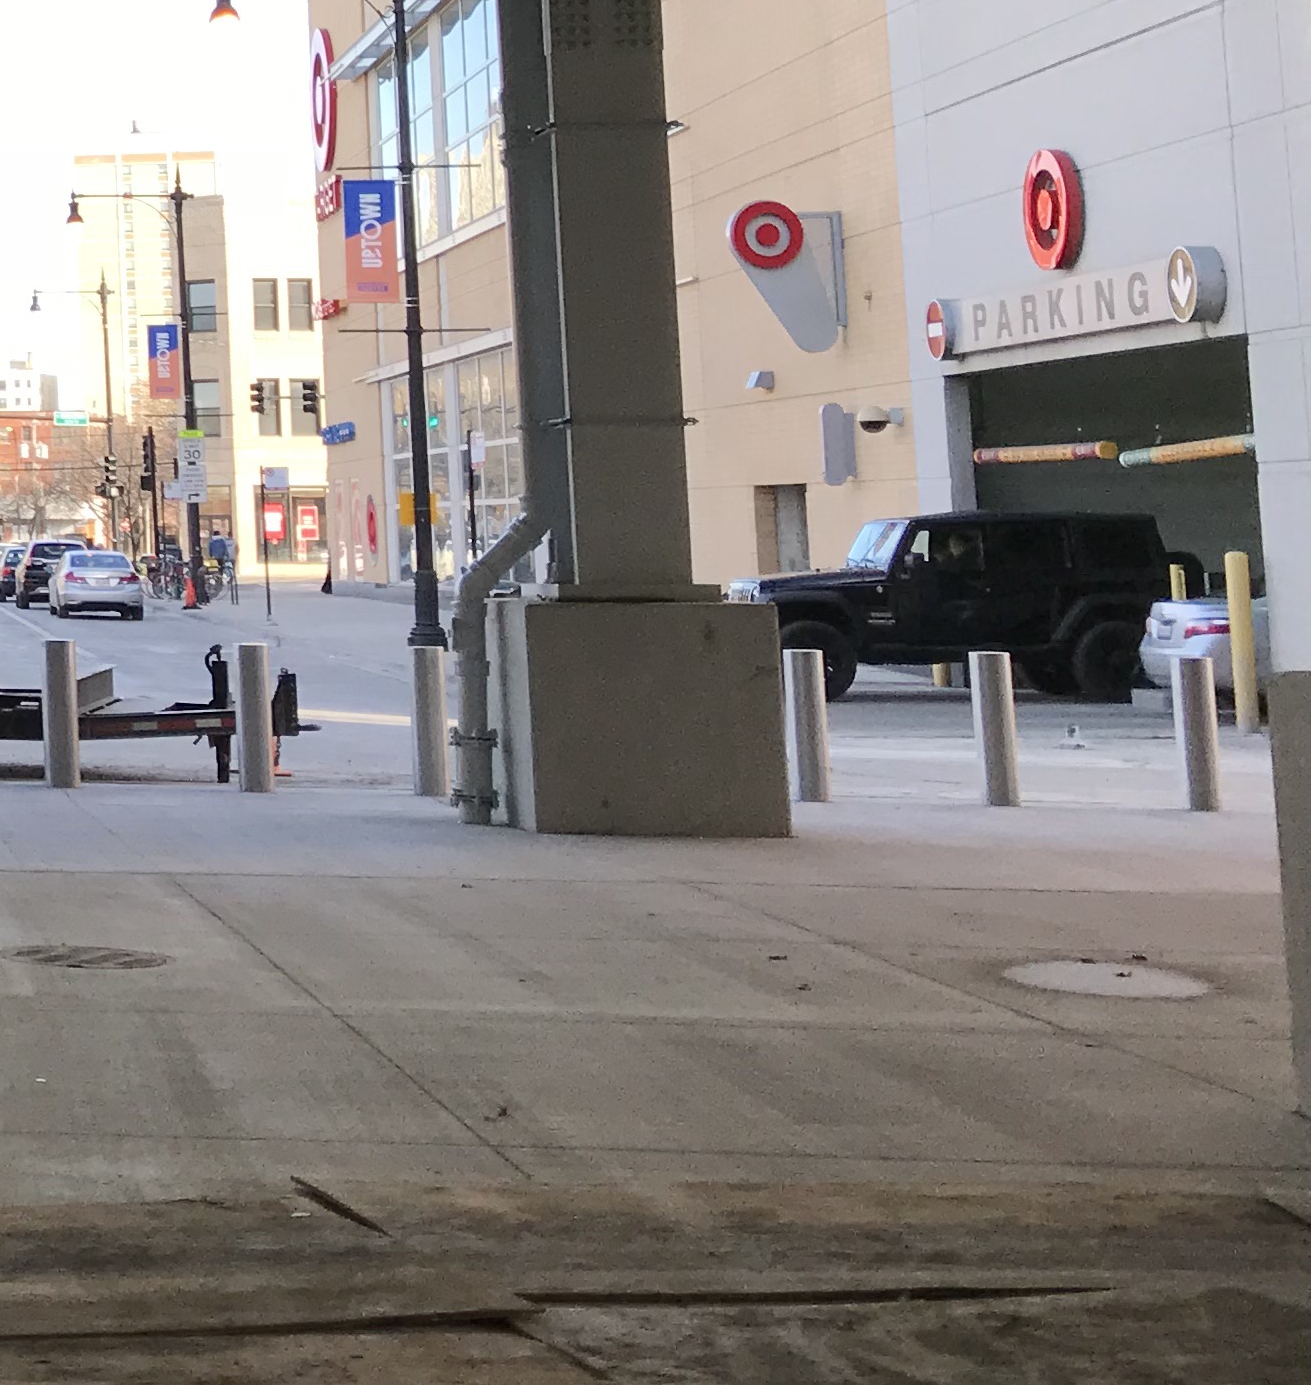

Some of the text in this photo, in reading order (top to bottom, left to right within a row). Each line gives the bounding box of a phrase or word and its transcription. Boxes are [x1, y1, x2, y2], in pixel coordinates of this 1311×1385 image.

[359, 193, 383, 268] UPTOWN
[972, 271, 1149, 342] PARKING
[184, 449, 201, 460] 30
